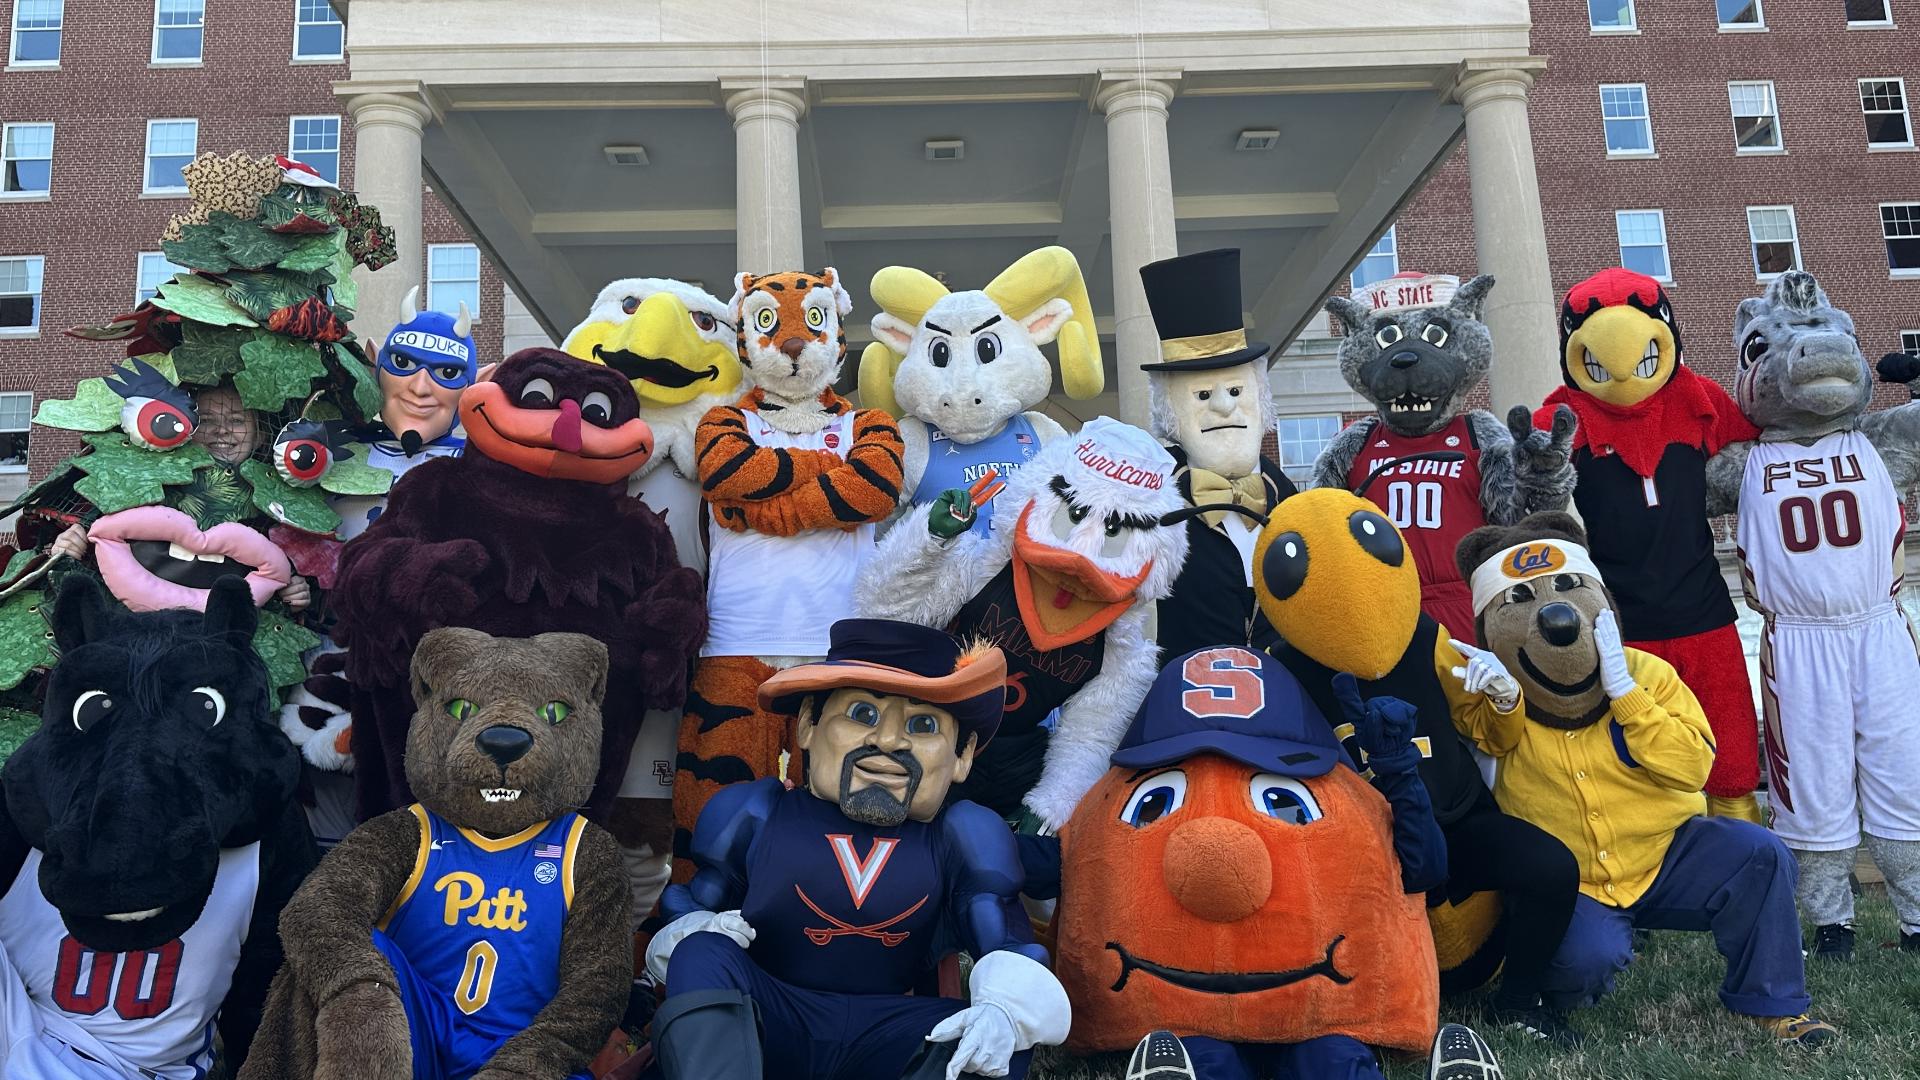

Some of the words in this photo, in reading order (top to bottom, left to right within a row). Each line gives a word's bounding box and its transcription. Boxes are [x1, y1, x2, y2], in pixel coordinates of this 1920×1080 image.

[1371, 290, 1389, 310] NC
[1398, 284, 1434, 306] STATE
[393, 332, 417, 345] GO
[422, 334, 467, 359] DUKE
[963, 461, 1021, 483] NORT
[1074, 438, 1164, 491] Hurricanes
[1368, 457, 1397, 477] NC
[1398, 458, 1466, 479] STATE
[1762, 453, 1867, 495] FSU
[1386, 481, 1443, 530] 00
[1777, 489, 1864, 555] 00
[1513, 546, 1553, 575] Cal
[1182, 647, 1265, 719] S
[824, 833, 902, 911] V
[434, 871, 528, 932] Pitt
[51, 931, 185, 1021] 00
[453, 940, 499, 1016] 0
